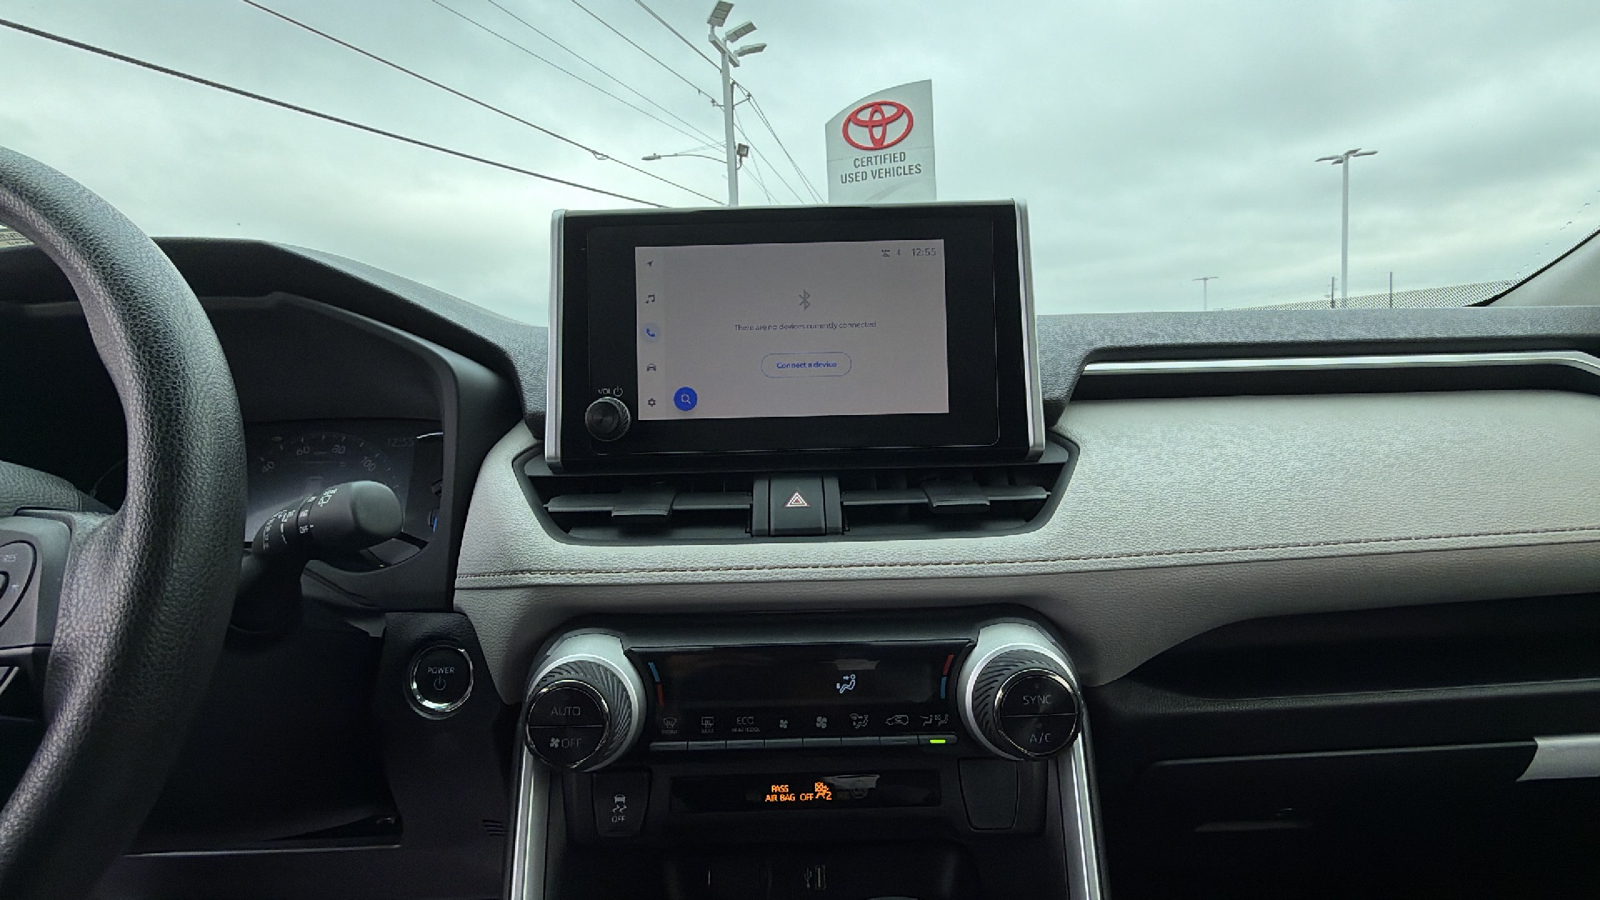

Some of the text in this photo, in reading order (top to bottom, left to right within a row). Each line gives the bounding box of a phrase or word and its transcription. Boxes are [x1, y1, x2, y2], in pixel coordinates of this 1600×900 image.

[853, 152, 906, 168] CERTIFIED
[841, 164, 922, 184] USED VEHICLES
[911, 247, 937, 257] 12:55
[779, 322, 805, 330] devices
[806, 321, 837, 331] currently
[776, 361, 806, 369] Connect
[296, 446, 310, 456] 60
[331, 445, 346, 454] 80
[360, 457, 377, 473] 100
[1022, 694, 1052, 705] SYNC
[551, 706, 581, 717] AUTO
[736, 716, 754, 725] ECO
[1030, 732, 1051, 743] A/C
[561, 738, 582, 748] OFF
[771, 785, 789, 793] PASS
[765, 793, 814, 802] AIR BAG OFF
[611, 815, 626, 823] OFF
